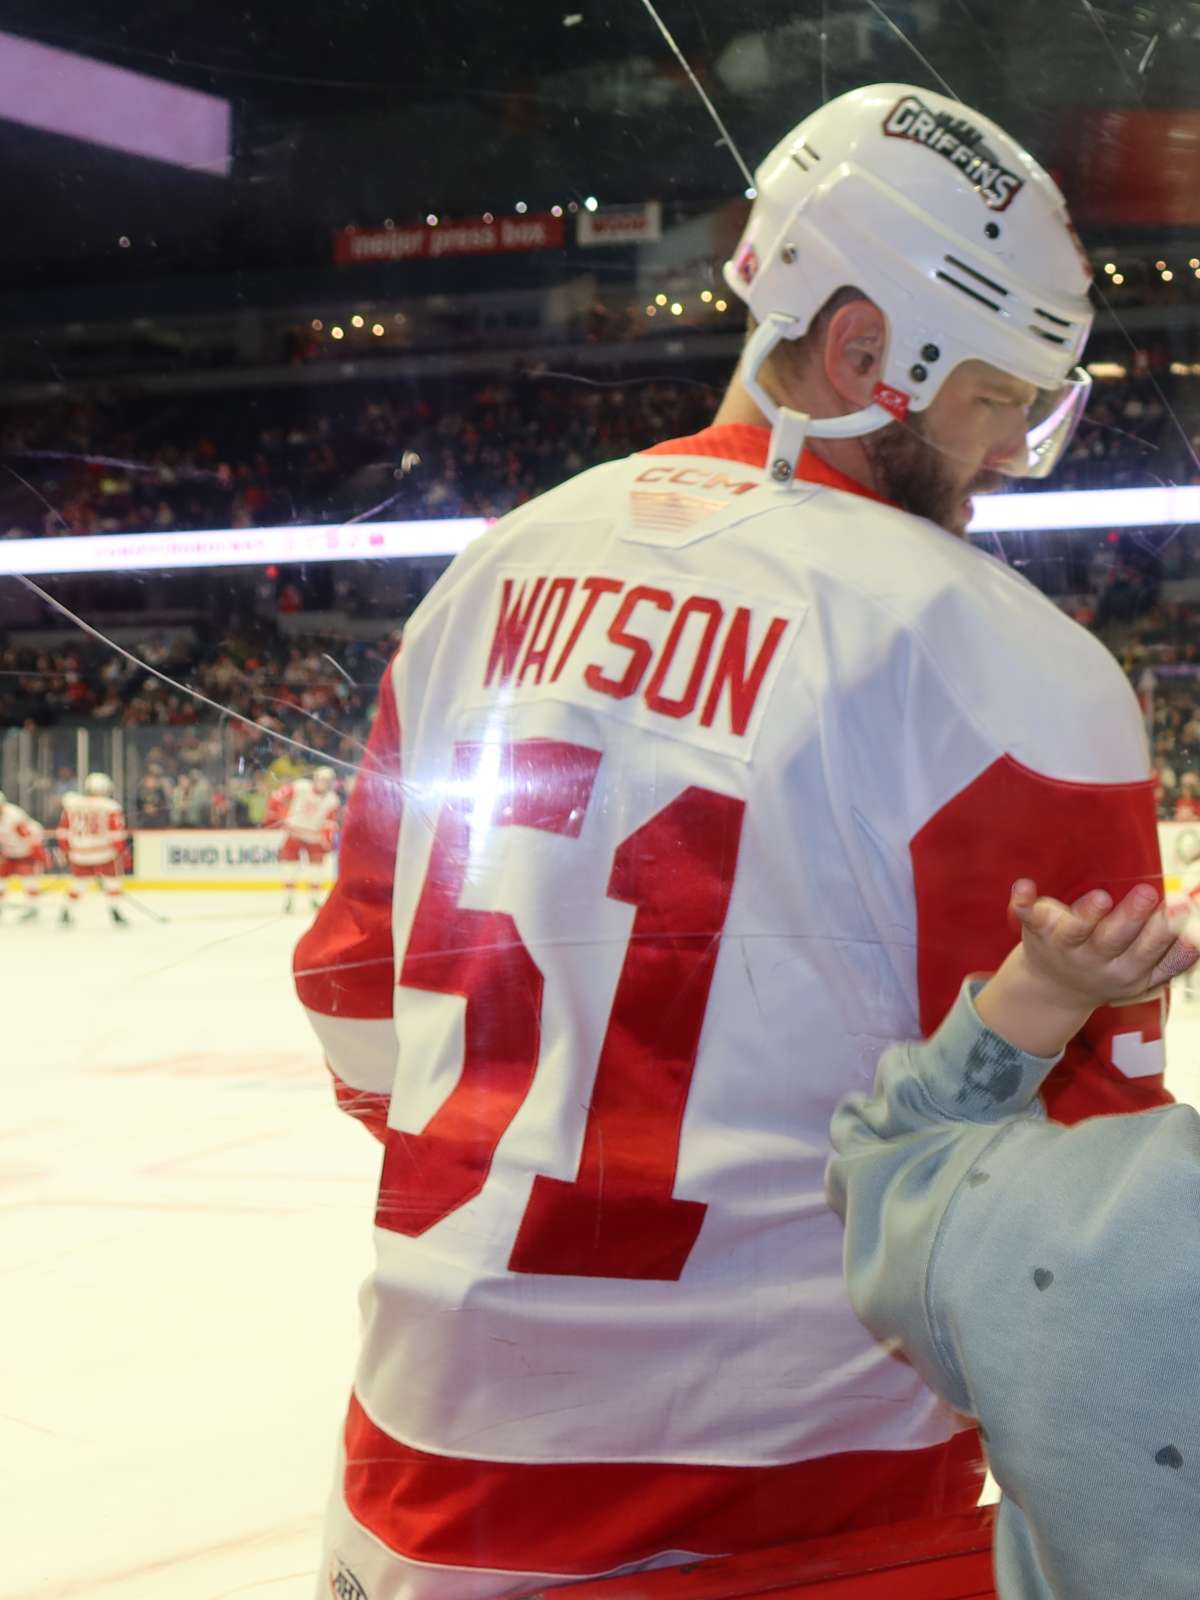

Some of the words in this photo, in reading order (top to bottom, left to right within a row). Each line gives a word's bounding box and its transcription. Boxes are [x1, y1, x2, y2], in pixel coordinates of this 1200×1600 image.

[884, 98, 1022, 210] GRIFFINS
[430, 227, 497, 255] press
[502, 221, 546, 246] box
[634, 467, 760, 496] CCM
[483, 575, 790, 737] WATSON
[168, 847, 219, 866] BUD
[225, 847, 280, 866] LIGH
[374, 737, 746, 1282] 51
